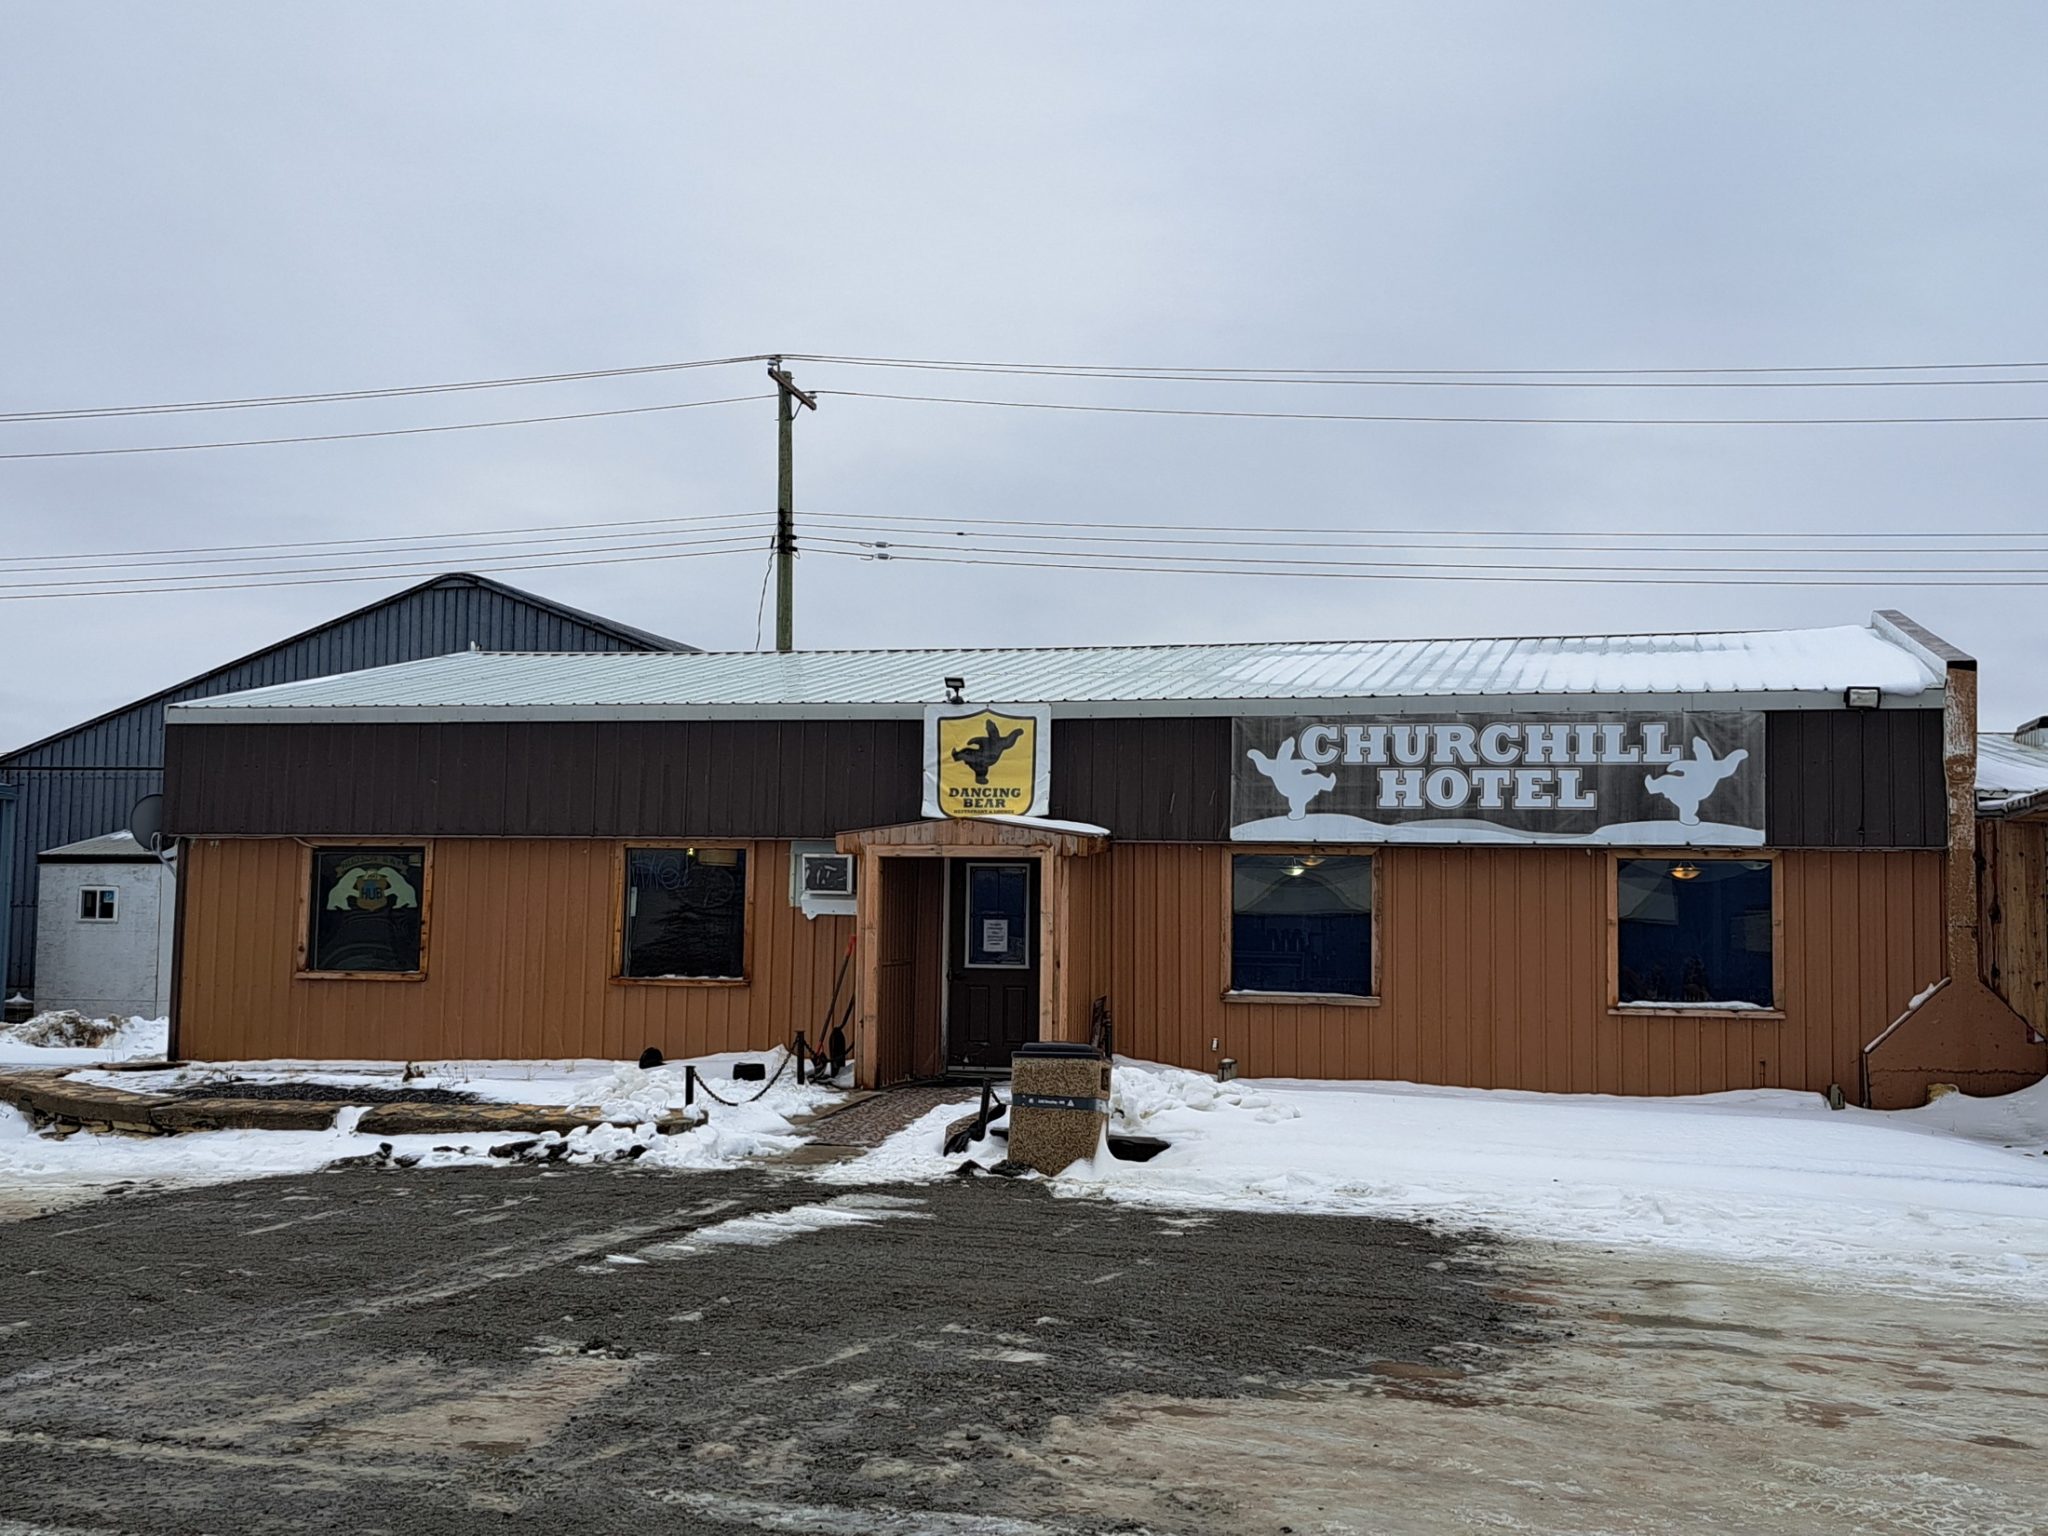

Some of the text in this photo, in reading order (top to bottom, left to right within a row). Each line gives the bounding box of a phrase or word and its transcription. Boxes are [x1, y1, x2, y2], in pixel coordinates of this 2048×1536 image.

[1299, 722, 1683, 765] CHURCHILL
[949, 788, 1021, 798] DANCING
[1376, 768, 1598, 809] HOTEL
[964, 798, 1005, 808] BEAR
[361, 887, 383, 900] HUB
